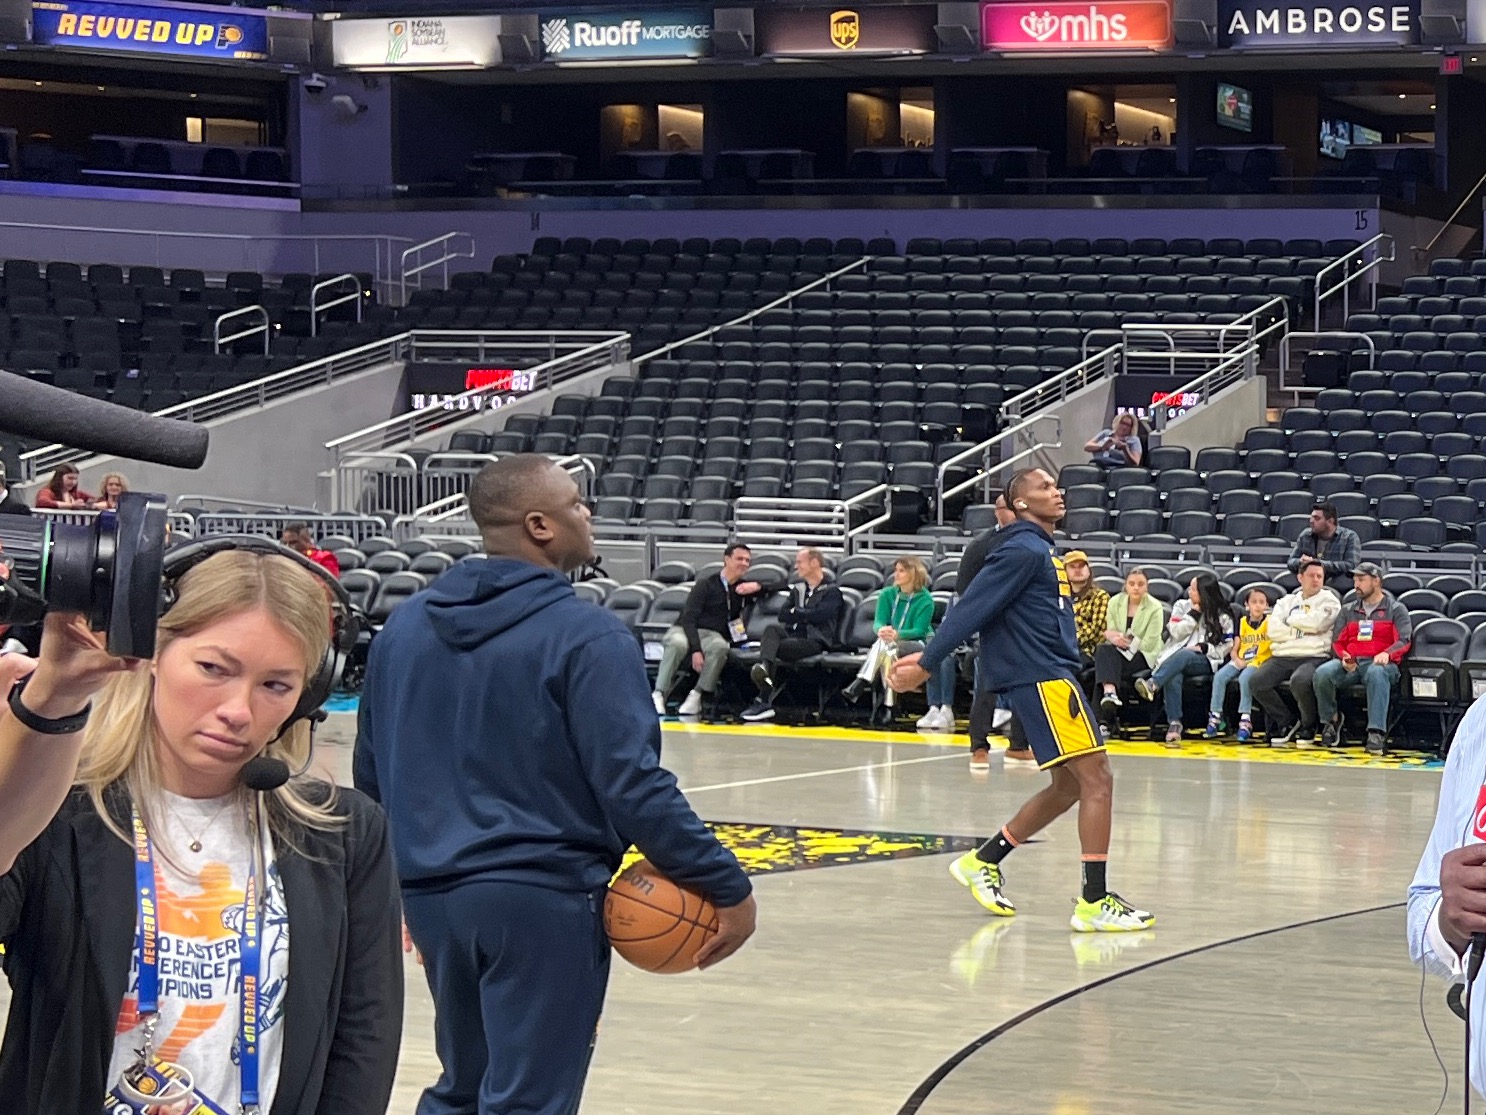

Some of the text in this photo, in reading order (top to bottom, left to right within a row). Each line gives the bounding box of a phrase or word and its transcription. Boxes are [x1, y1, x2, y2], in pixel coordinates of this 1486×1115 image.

[57, 13, 171, 42] REVVED
[175, 22, 215, 45] UP
[573, 20, 710, 47] Ruoff MORTGAGE
[833, 20, 857, 43] ups
[1061, 6, 1127, 41] mhs
[1228, 6, 1410, 35] AMBROSE
[1354, 210, 1368, 231] 15
[141, 897, 157, 965] REVVED UP
[243, 975, 256, 1042] REVVED UP
